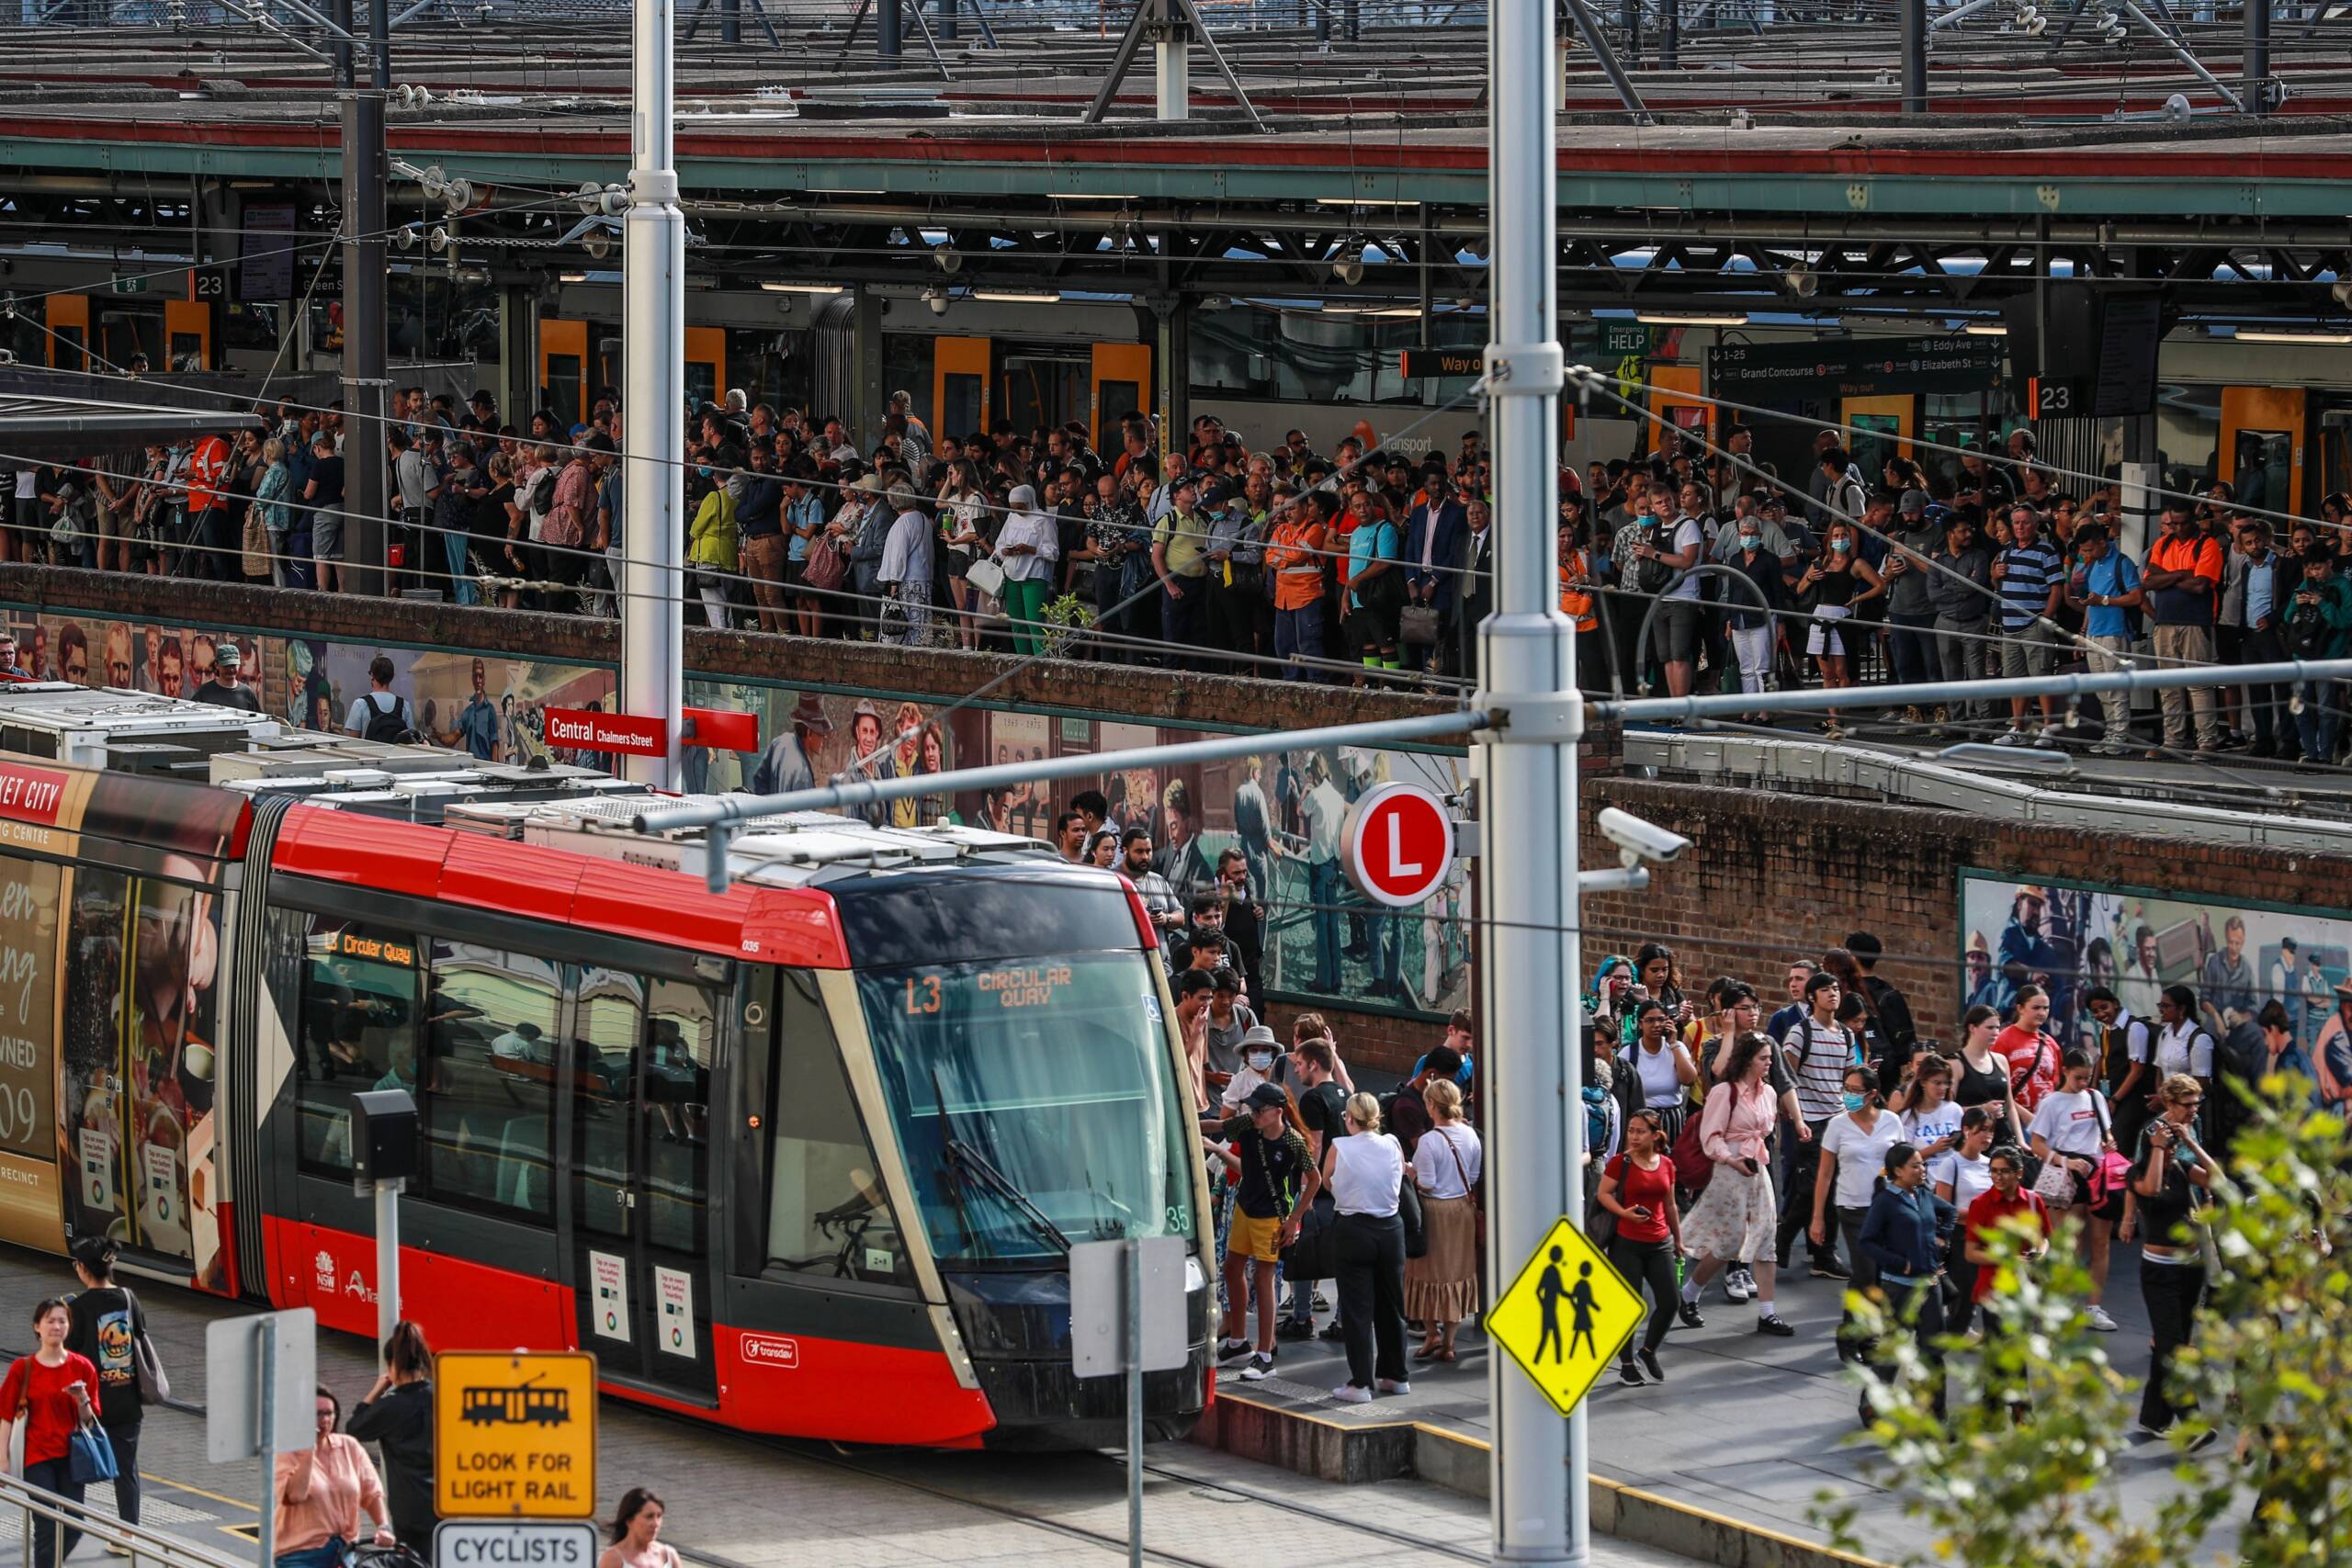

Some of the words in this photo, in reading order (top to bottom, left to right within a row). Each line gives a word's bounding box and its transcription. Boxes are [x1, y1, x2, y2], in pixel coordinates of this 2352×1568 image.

[198, 276, 222, 294] 23
[1609, 325, 1645, 334] Emergency
[1609, 334, 1645, 349] HELP
[1933, 341, 1953, 352] Eddy
[1955, 340, 1972, 349] Ave
[1724, 350, 1747, 360] 1-25
[1921, 359, 1962, 369] Elizabeth
[1962, 358, 1972, 367] St
[1441, 356, 1470, 374] Way
[1741, 368, 1767, 379] Grand
[1768, 367, 1814, 378] Concourse
[1839, 383, 1857, 394] Way
[1858, 383, 1874, 392] out
[2041, 387, 2069, 409] 23
[1381, 433, 1432, 455] Transport
[551, 717, 594, 741] Central
[596, 729, 630, 745] Chalmers
[630, 734, 653, 748] Street
[25, 781, 59, 811] CITY
[13, 826, 49, 844] CENTRE
[1387, 812, 1422, 877] L
[344, 934, 382, 956] Circular
[384, 942, 412, 964] Quay
[742, 940, 760, 952] 035
[907, 975, 941, 1015] L3
[978, 967, 1071, 991] CIRCULAR
[1001, 987, 1051, 1008] QUAY
[1167, 1205, 1190, 1232] 35
[316, 1272, 334, 1288] NSW
[760, 1347, 793, 1359] transdev
[456, 1451, 516, 1472] LOOK
[526, 1452, 571, 1472] FOR
[451, 1481, 515, 1500] LIGHT
[525, 1482, 577, 1500] RAIL
[454, 1538, 579, 1562] CYCLISTS
